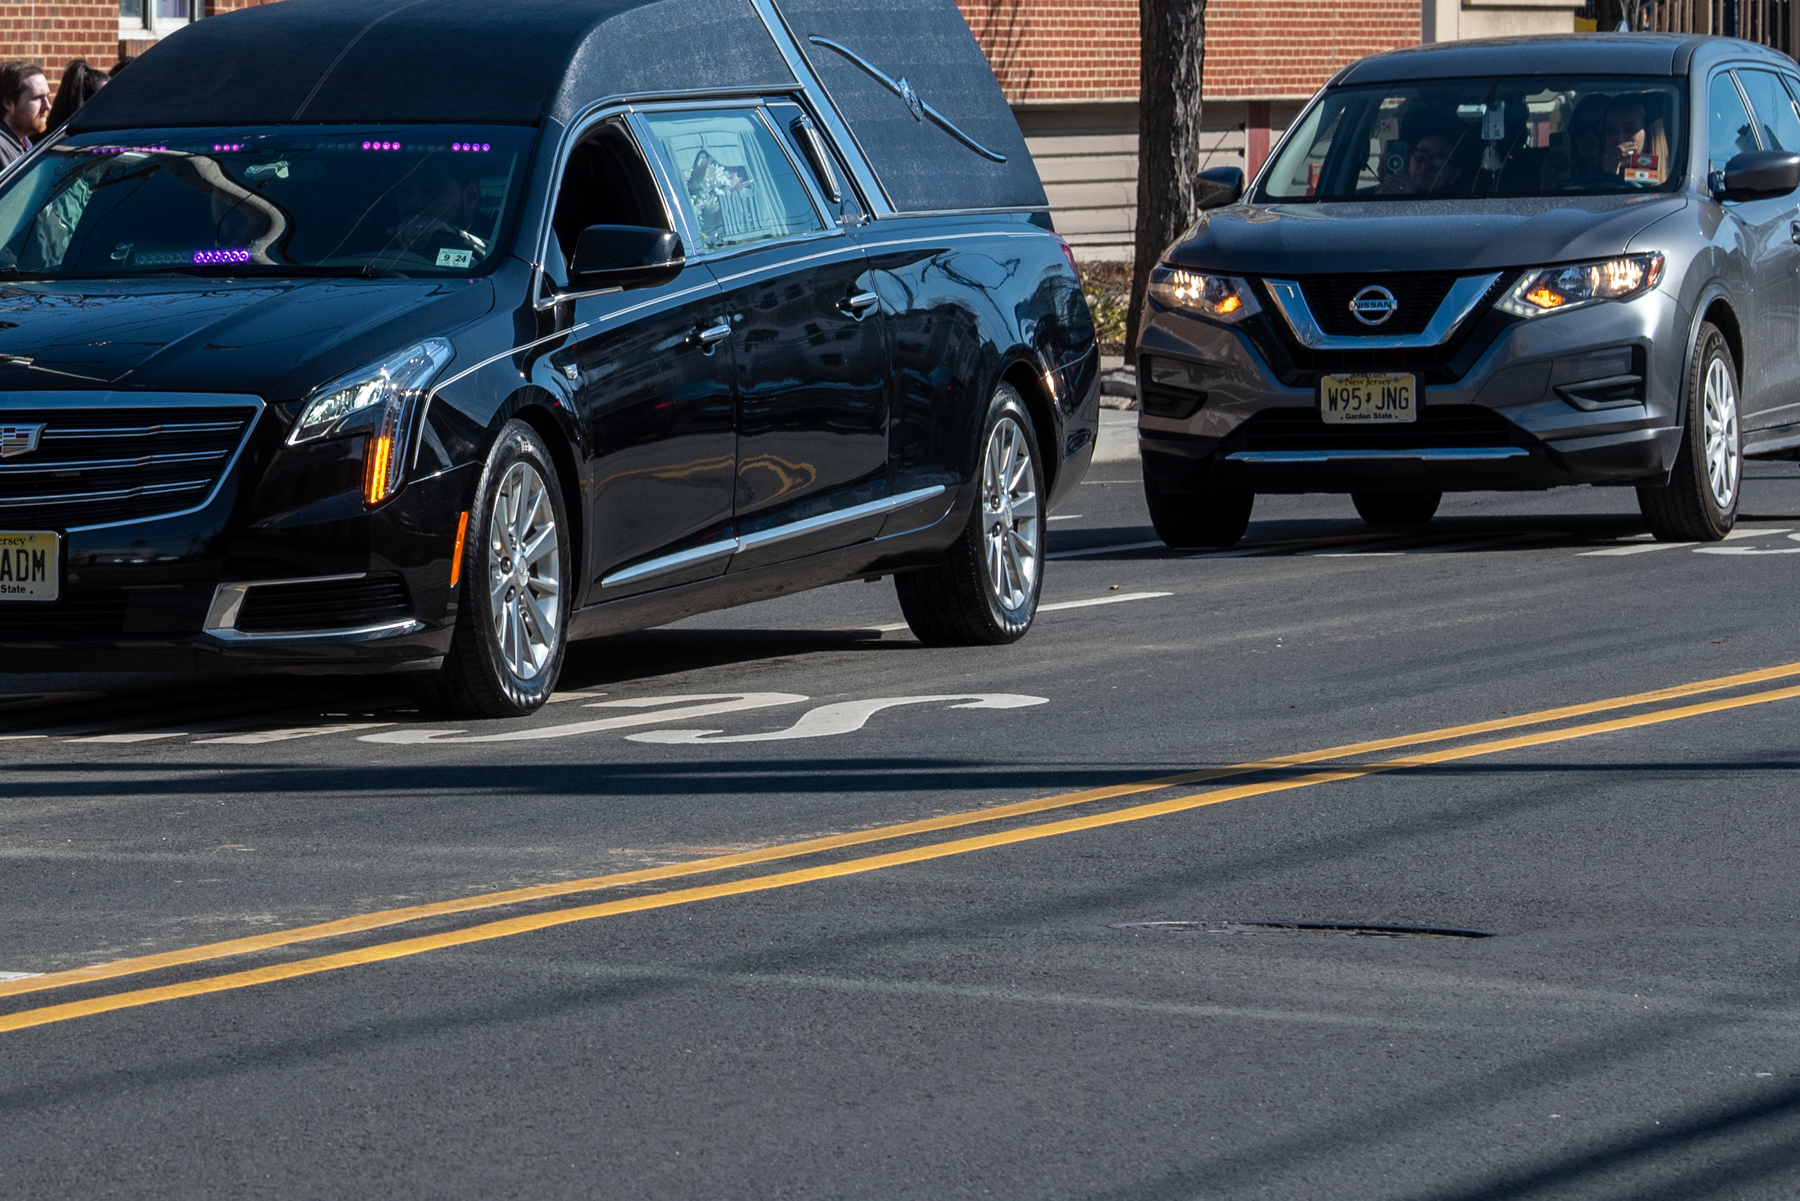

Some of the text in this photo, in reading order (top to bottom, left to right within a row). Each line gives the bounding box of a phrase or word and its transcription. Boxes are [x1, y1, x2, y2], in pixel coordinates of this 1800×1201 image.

[443, 254, 467, 263] 9 24
[1354, 301, 1391, 309] NISSAN
[1344, 378, 1392, 387] New Jersey
[1328, 386, 1409, 411] W95 JNG
[0, 548, 46, 582] ADM
[0, 584, 26, 594] State
